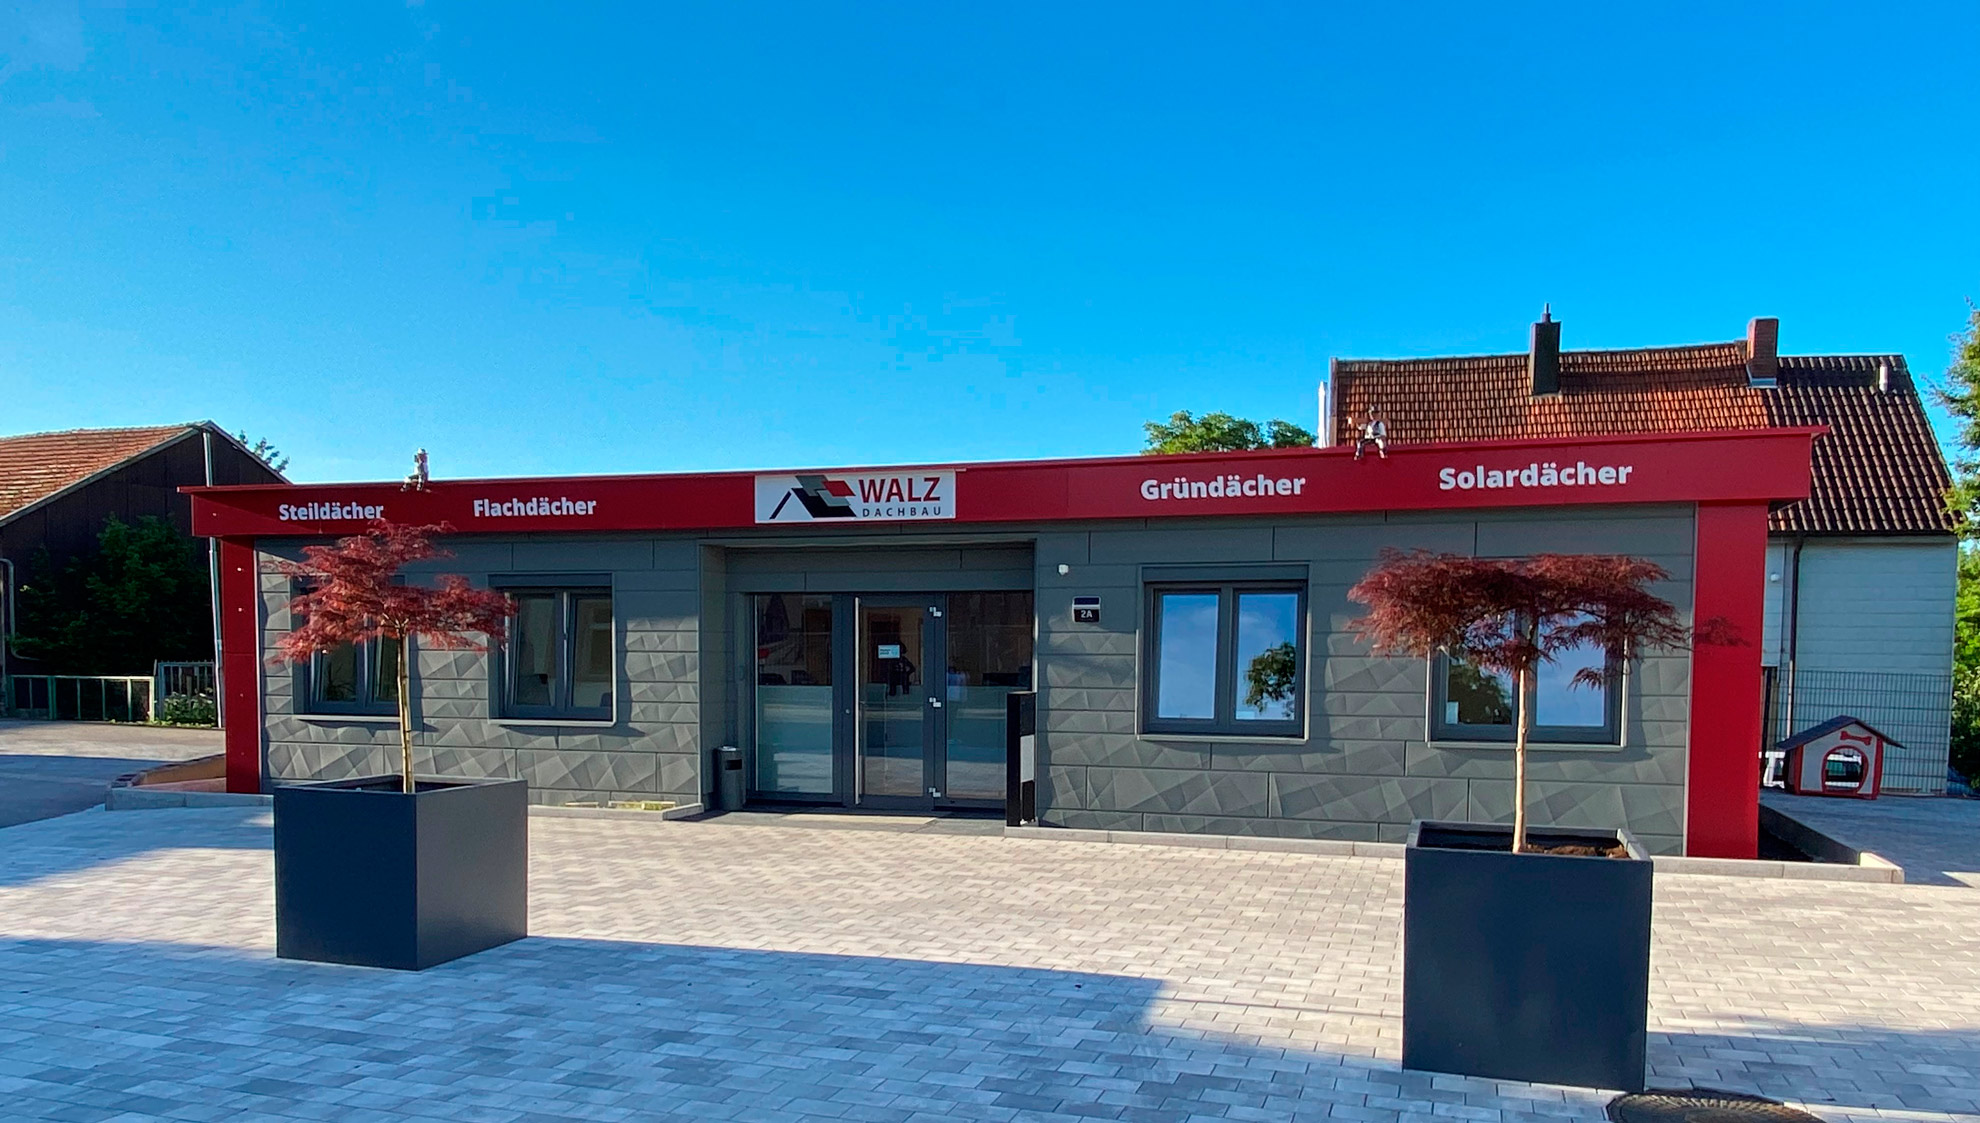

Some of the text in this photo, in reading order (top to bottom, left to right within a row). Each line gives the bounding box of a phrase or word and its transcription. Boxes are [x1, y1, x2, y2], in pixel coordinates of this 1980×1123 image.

[1439, 461, 1633, 490] Solardächer
[858, 477, 941, 503] WALZ
[1140, 475, 1305, 500] Gründächer
[279, 501, 384, 520] Steildächer
[474, 497, 596, 517] Flachdächer
[863, 507, 941, 518] DACHBAU
[1080, 609, 1093, 618] 2A
